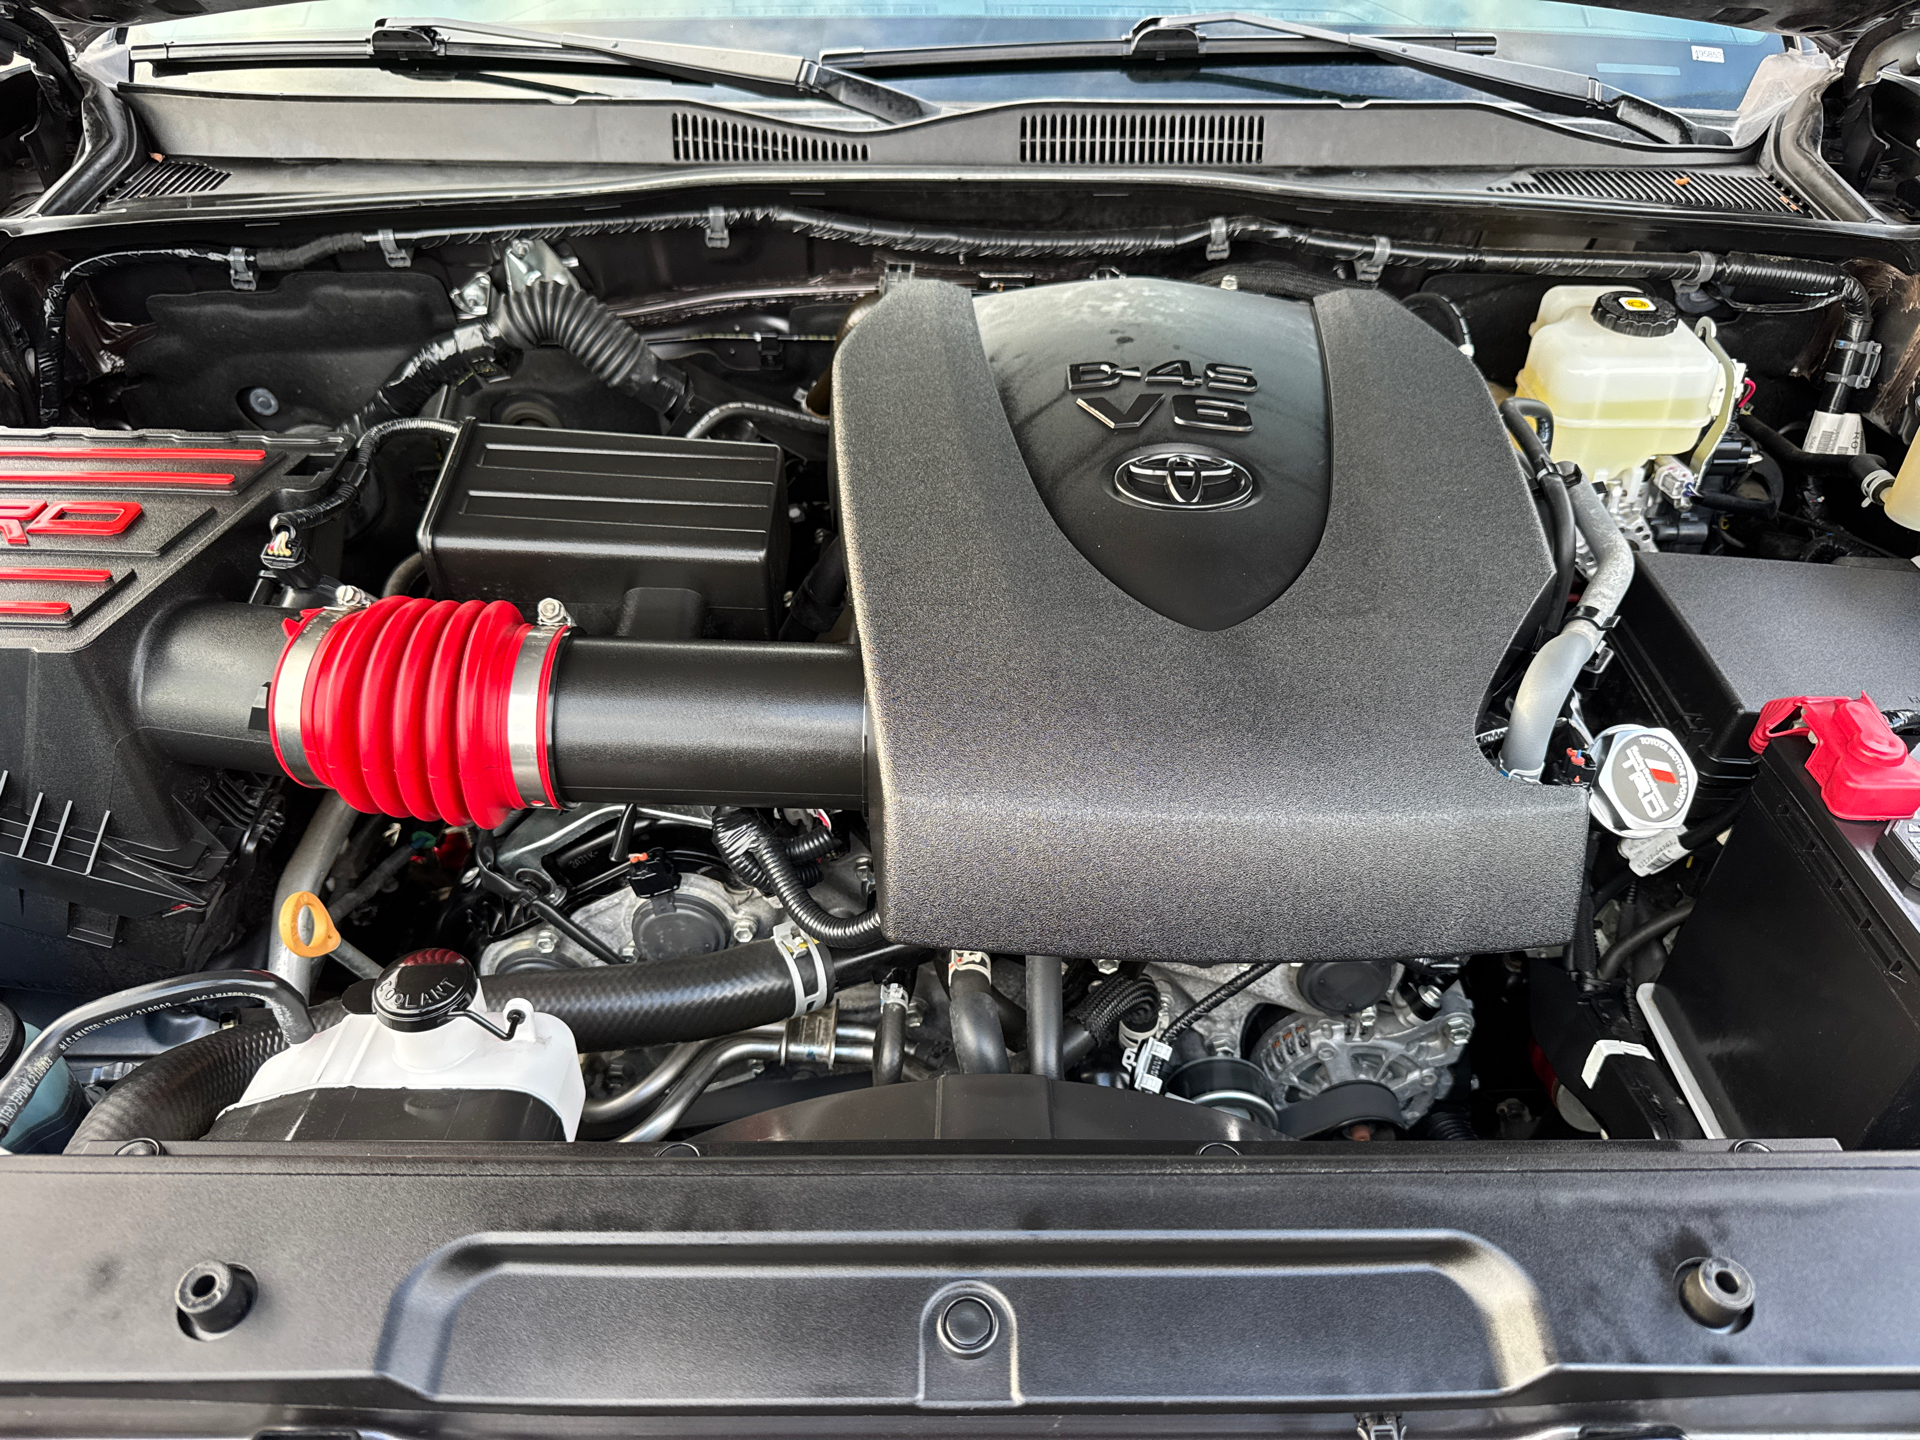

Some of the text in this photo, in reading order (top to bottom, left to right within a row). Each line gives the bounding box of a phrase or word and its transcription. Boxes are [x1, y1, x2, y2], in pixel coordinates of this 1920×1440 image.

[1067, 360, 1259, 393] D-4S
[1076, 394, 1255, 433] V6
[1621, 748, 1663, 819] TRD
[1639, 737, 1688, 809] TOYOTA MOTOR SPORTS
[379, 977, 456, 1009] COOLANT
